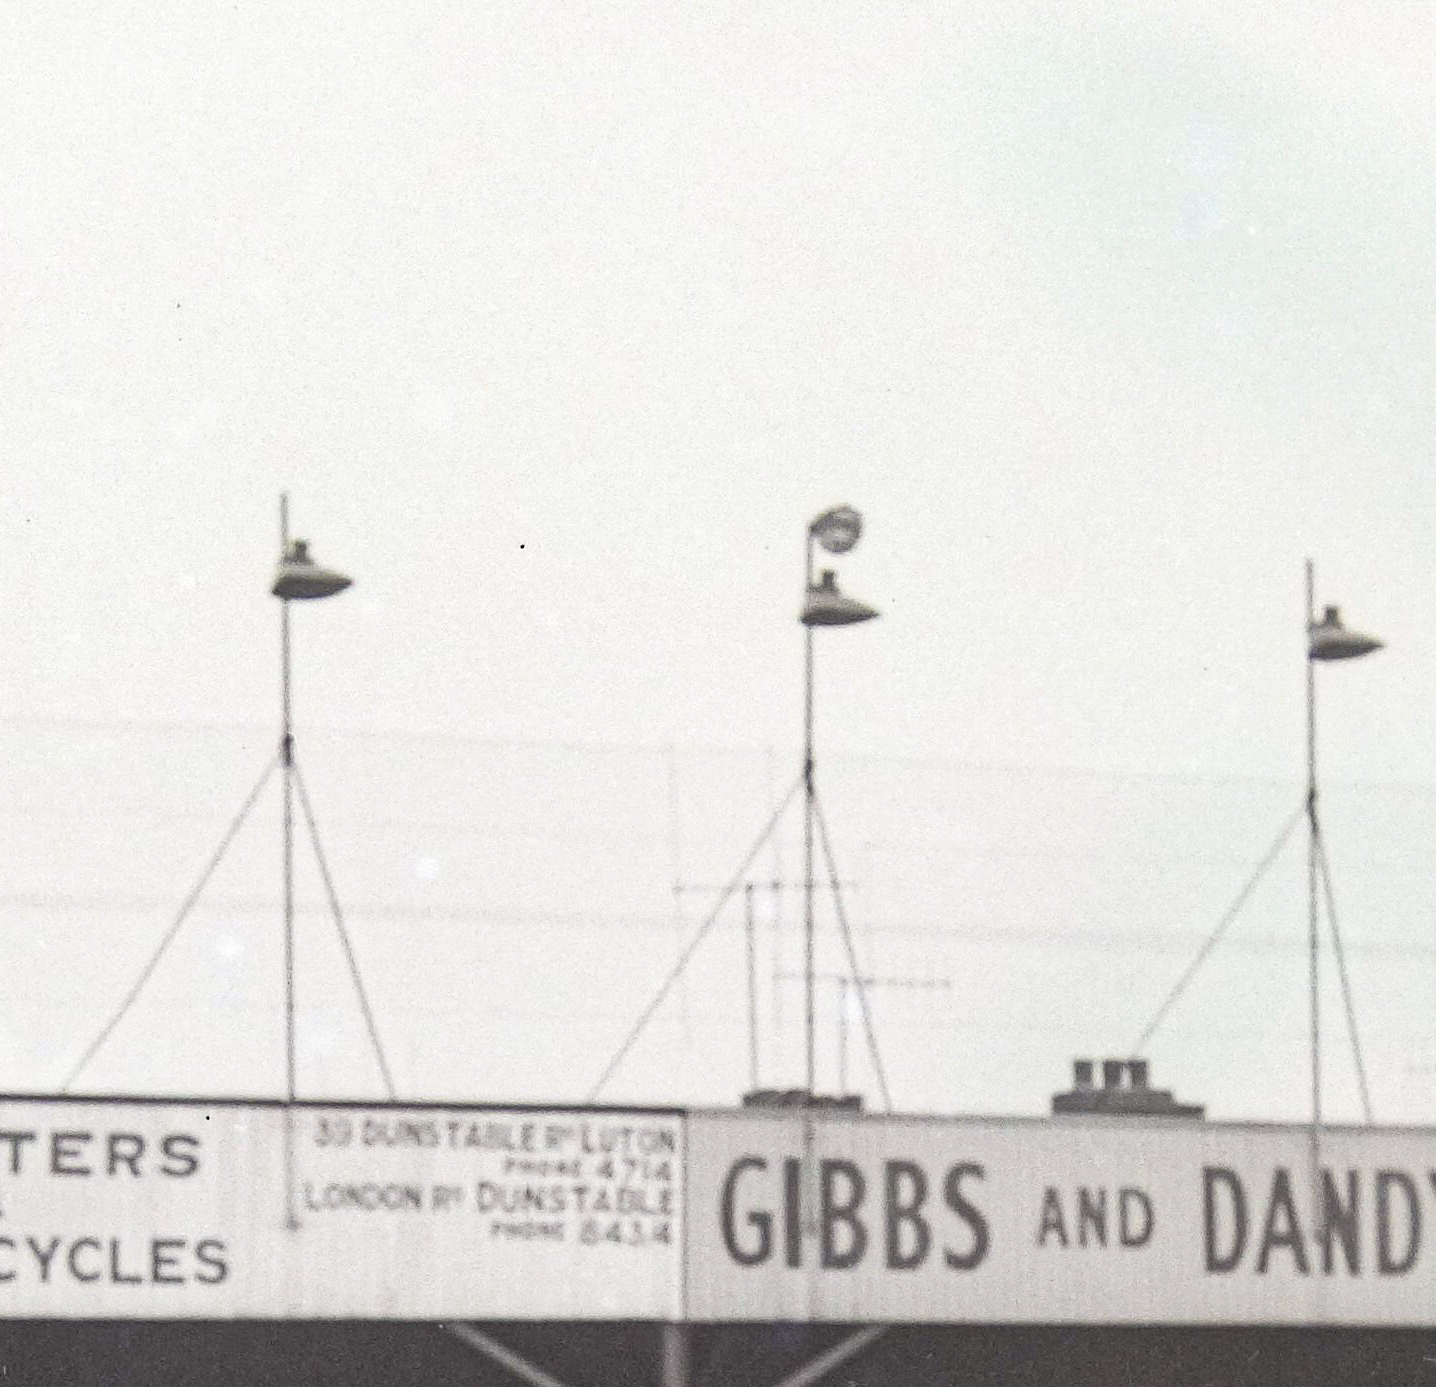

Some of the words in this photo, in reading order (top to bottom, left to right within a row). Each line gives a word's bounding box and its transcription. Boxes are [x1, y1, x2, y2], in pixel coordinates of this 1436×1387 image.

[361, 1117, 536, 1151] DUNSTABLE
[580, 1123, 676, 1154] LUTON
[303, 1181, 422, 1212] LONDON
[476, 1180, 673, 1216] DUNSTABLE
[718, 1155, 991, 1272] GIBBS
[1035, 1184, 1157, 1250] AND
